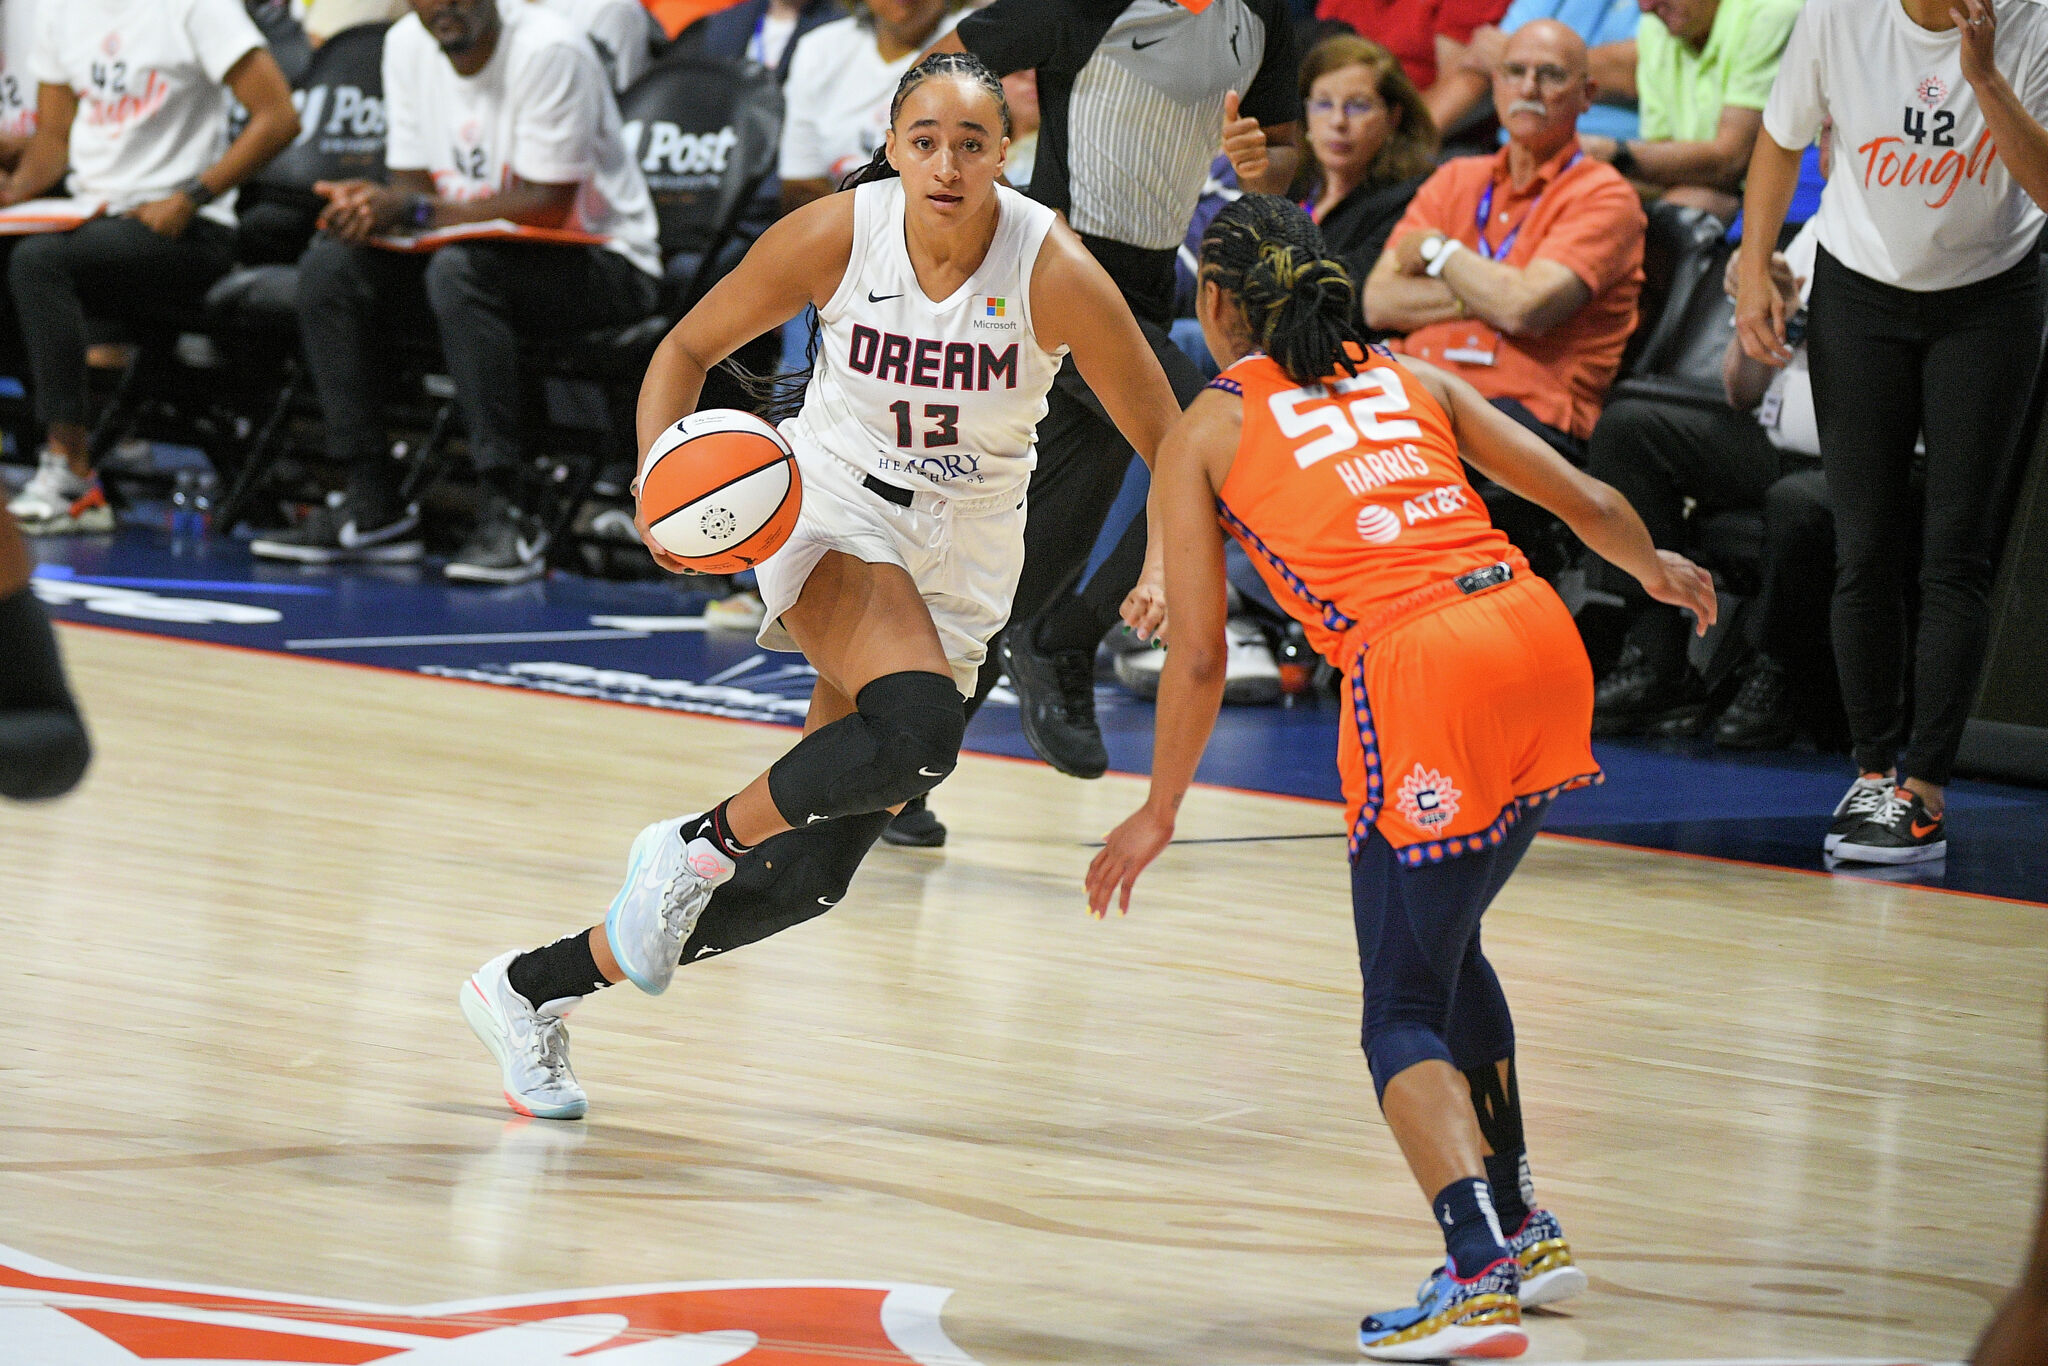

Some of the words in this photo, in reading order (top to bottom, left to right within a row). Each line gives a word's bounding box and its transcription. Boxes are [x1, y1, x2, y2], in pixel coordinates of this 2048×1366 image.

[91, 61, 126, 94] 42
[641, 121, 738, 173] Post
[1904, 106, 1955, 147] 42
[1858, 128, 1997, 209] Tough
[973, 319, 1017, 330] Microsoft
[849, 323, 1019, 391] DREAM
[889, 400, 959, 448] 13
[1268, 366, 1423, 470] 52
[1335, 443, 1430, 496] HARRIS
[1403, 484, 1469, 526] AT&T
